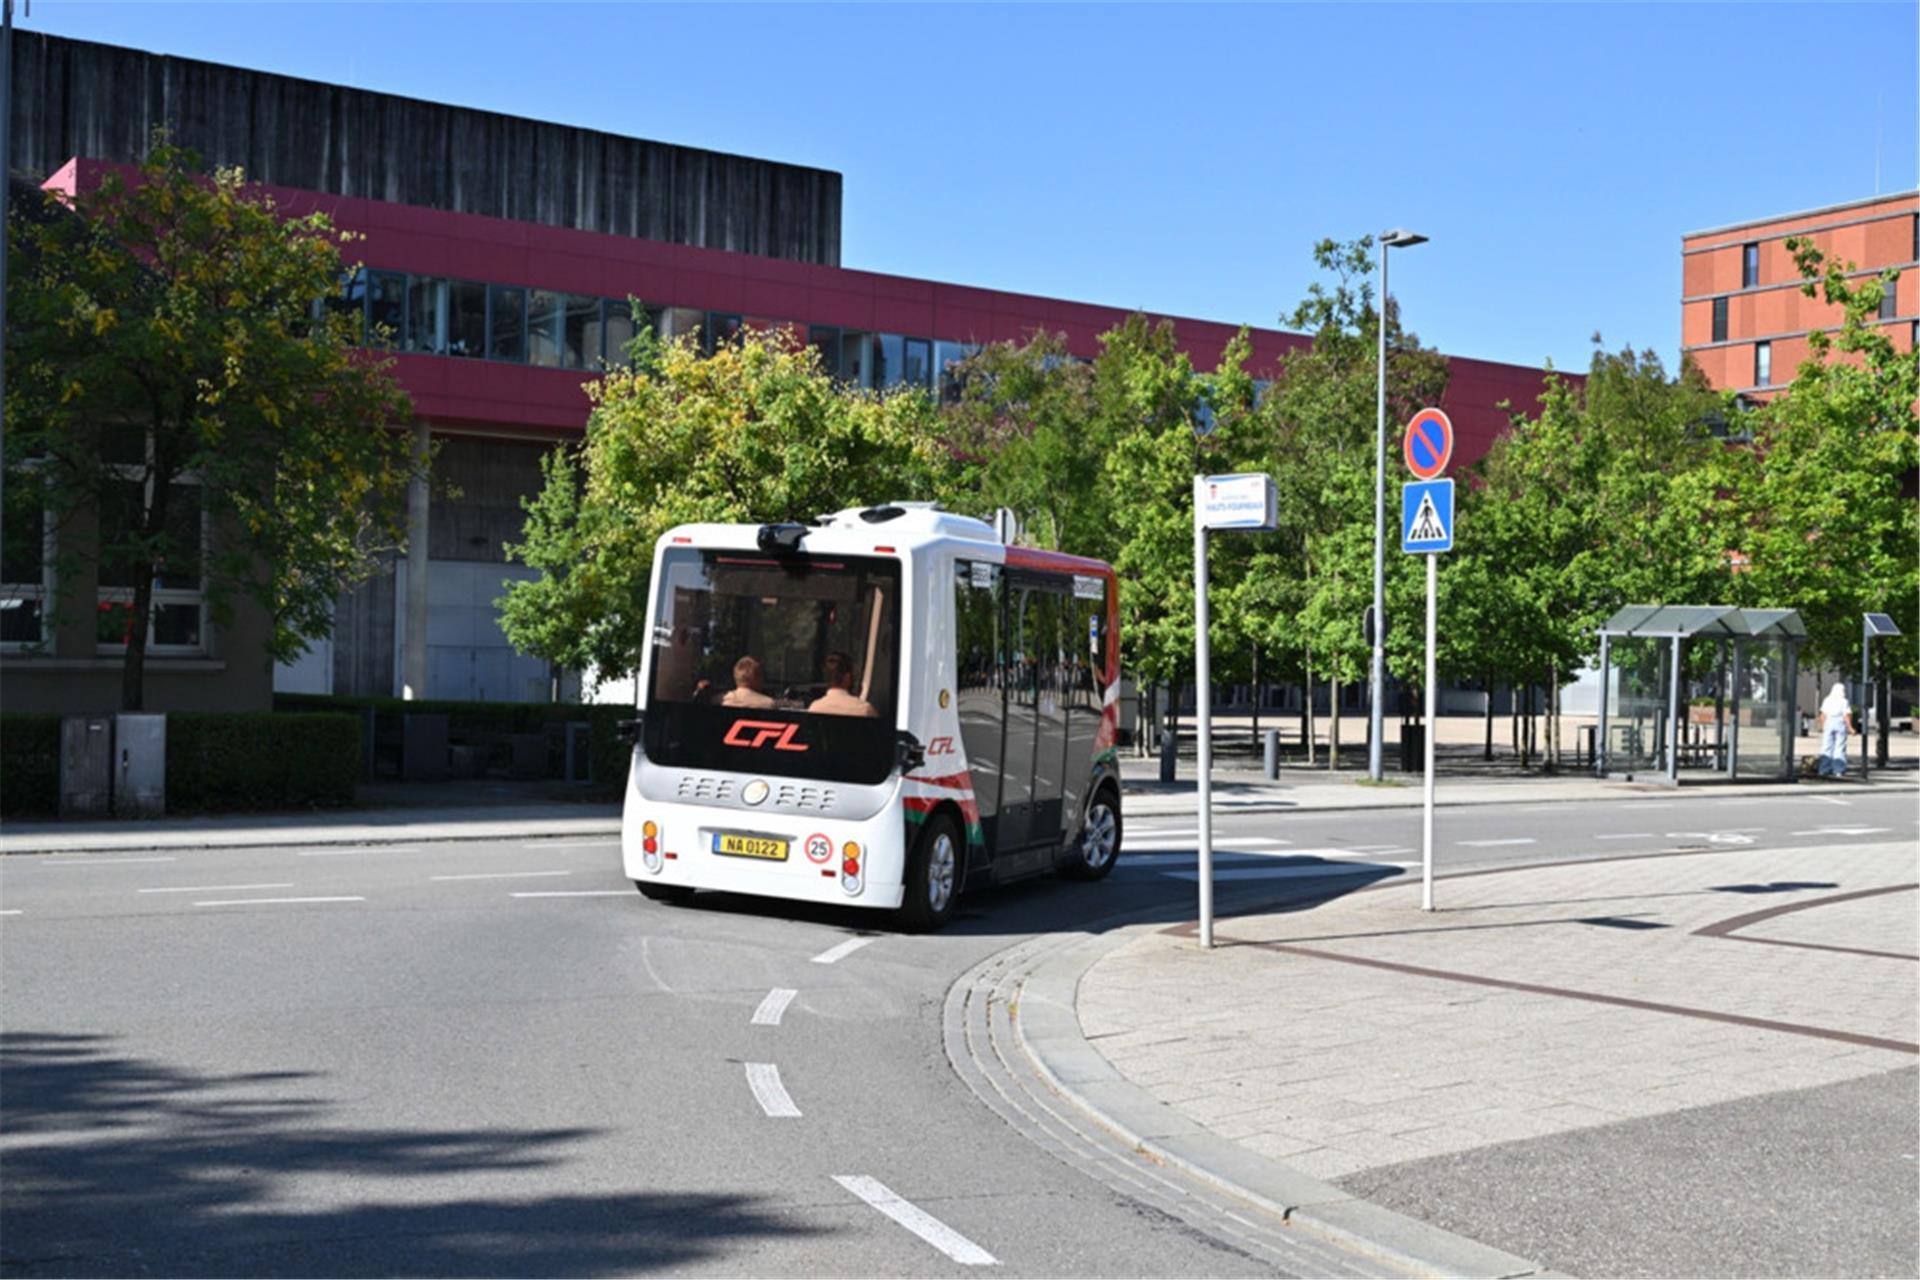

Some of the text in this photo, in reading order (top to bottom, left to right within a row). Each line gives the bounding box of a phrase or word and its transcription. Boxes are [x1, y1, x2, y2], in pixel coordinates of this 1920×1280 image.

[723, 719, 809, 751] CFL
[927, 735, 955, 755] CFL
[726, 837, 779, 856] NA 0122
[810, 841, 828, 856] 25
